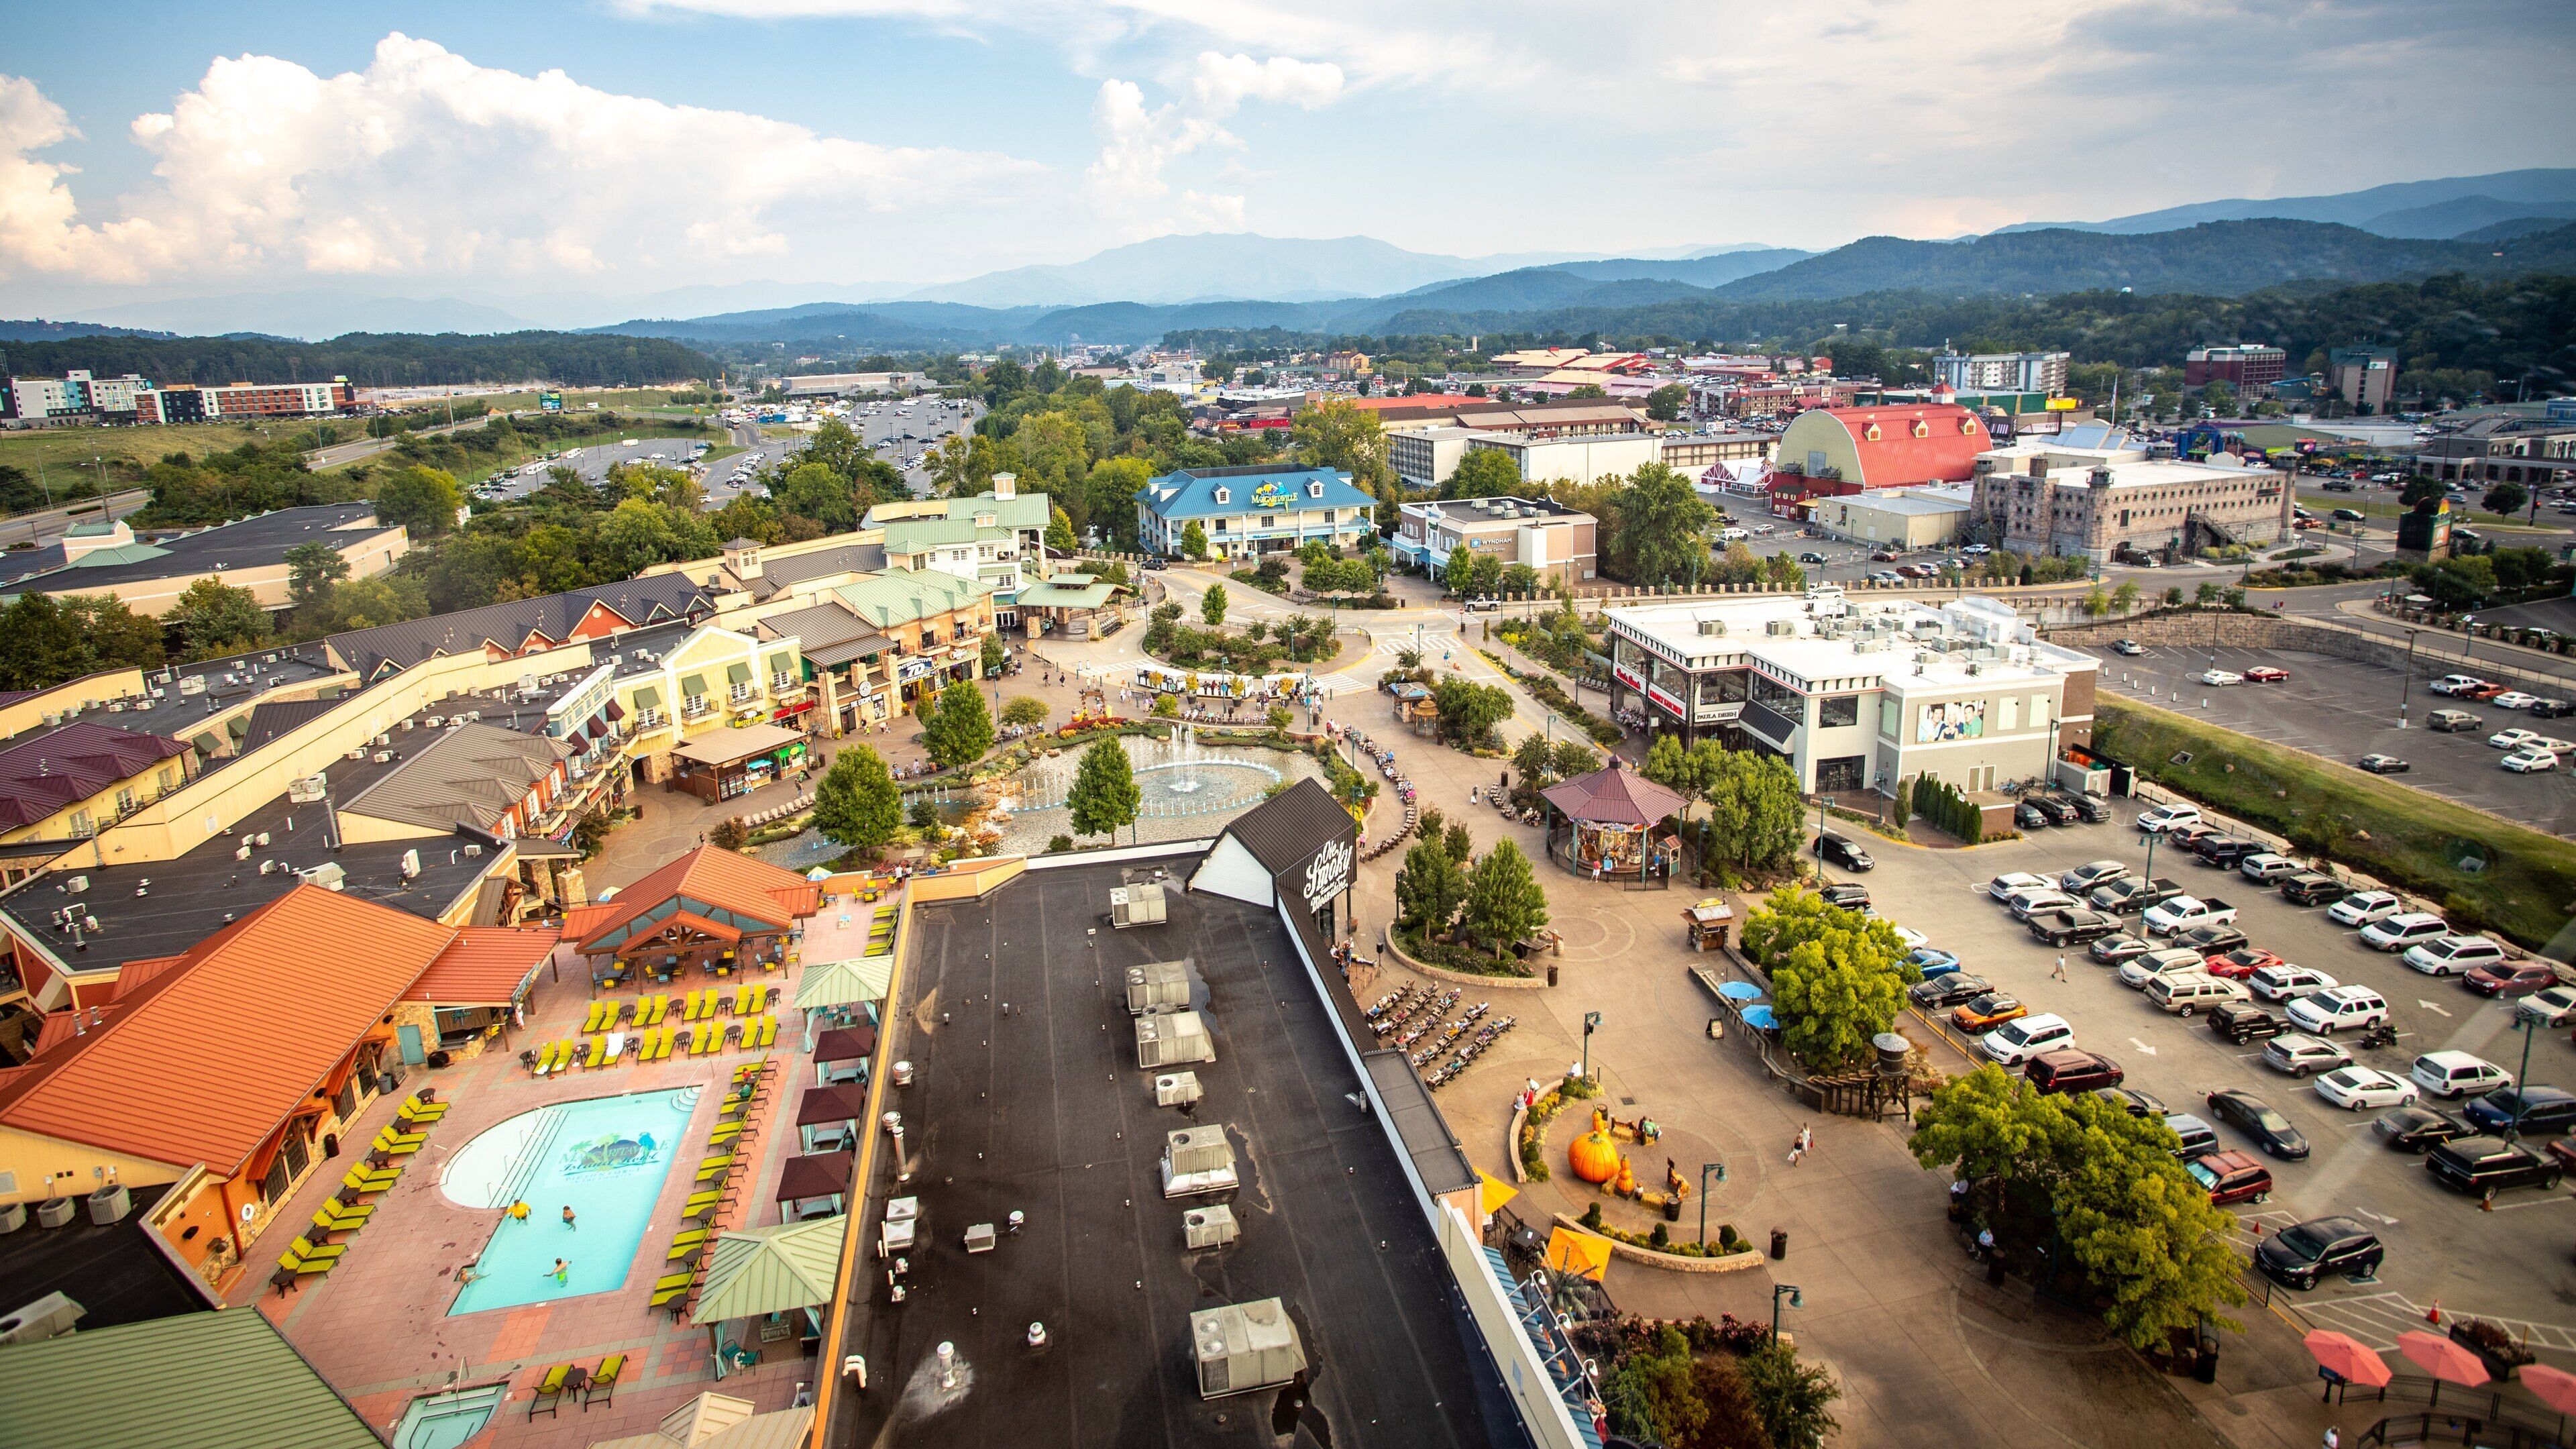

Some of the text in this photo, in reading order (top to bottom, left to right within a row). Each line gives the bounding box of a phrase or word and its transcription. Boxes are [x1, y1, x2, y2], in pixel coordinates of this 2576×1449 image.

[1251, 492, 1298, 504] MARGARITAVILLE
[1481, 537, 1512, 545] WYNDHAM
[898, 657, 932, 670] INTERACTIVE
[907, 663, 924, 678] 7D
[901, 672, 931, 684] ADVENTURE
[850, 692, 883, 708] THE ESCAPE GAME
[1323, 840, 1339, 864] Ole
[1303, 841, 1353, 899] Smoky
[1310, 879, 1348, 914] Moonshine
[559, 1139, 671, 1165] MARGARITAVE
[559, 1159, 613, 1172] Island
